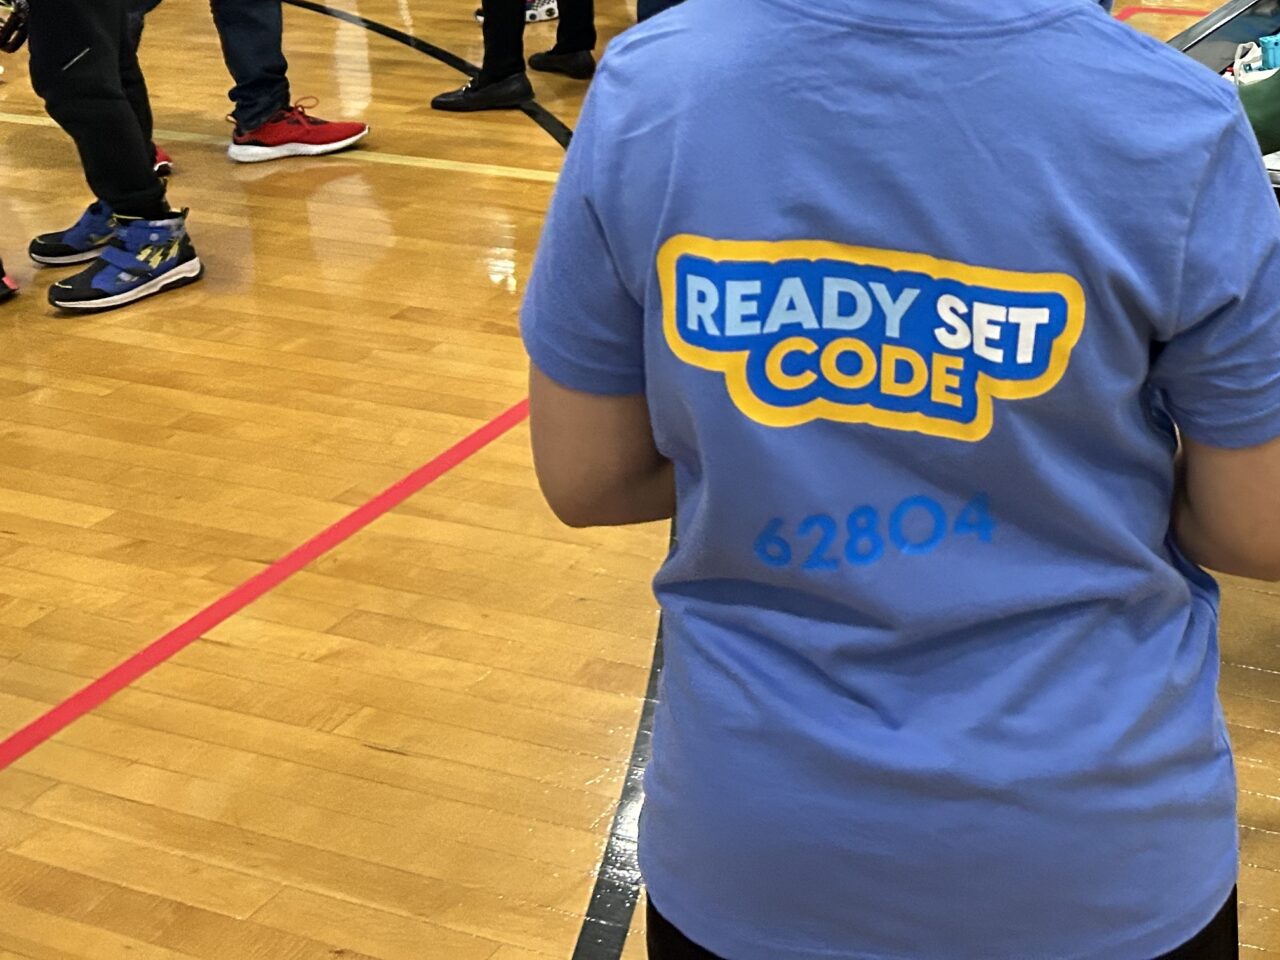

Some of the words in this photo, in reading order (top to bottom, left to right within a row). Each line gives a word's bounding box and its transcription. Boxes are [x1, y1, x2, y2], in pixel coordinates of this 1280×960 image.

[687, 275, 920, 339] READY
[934, 294, 1049, 364] SET
[765, 336, 965, 407] CODE
[753, 491, 998, 571] 62804
